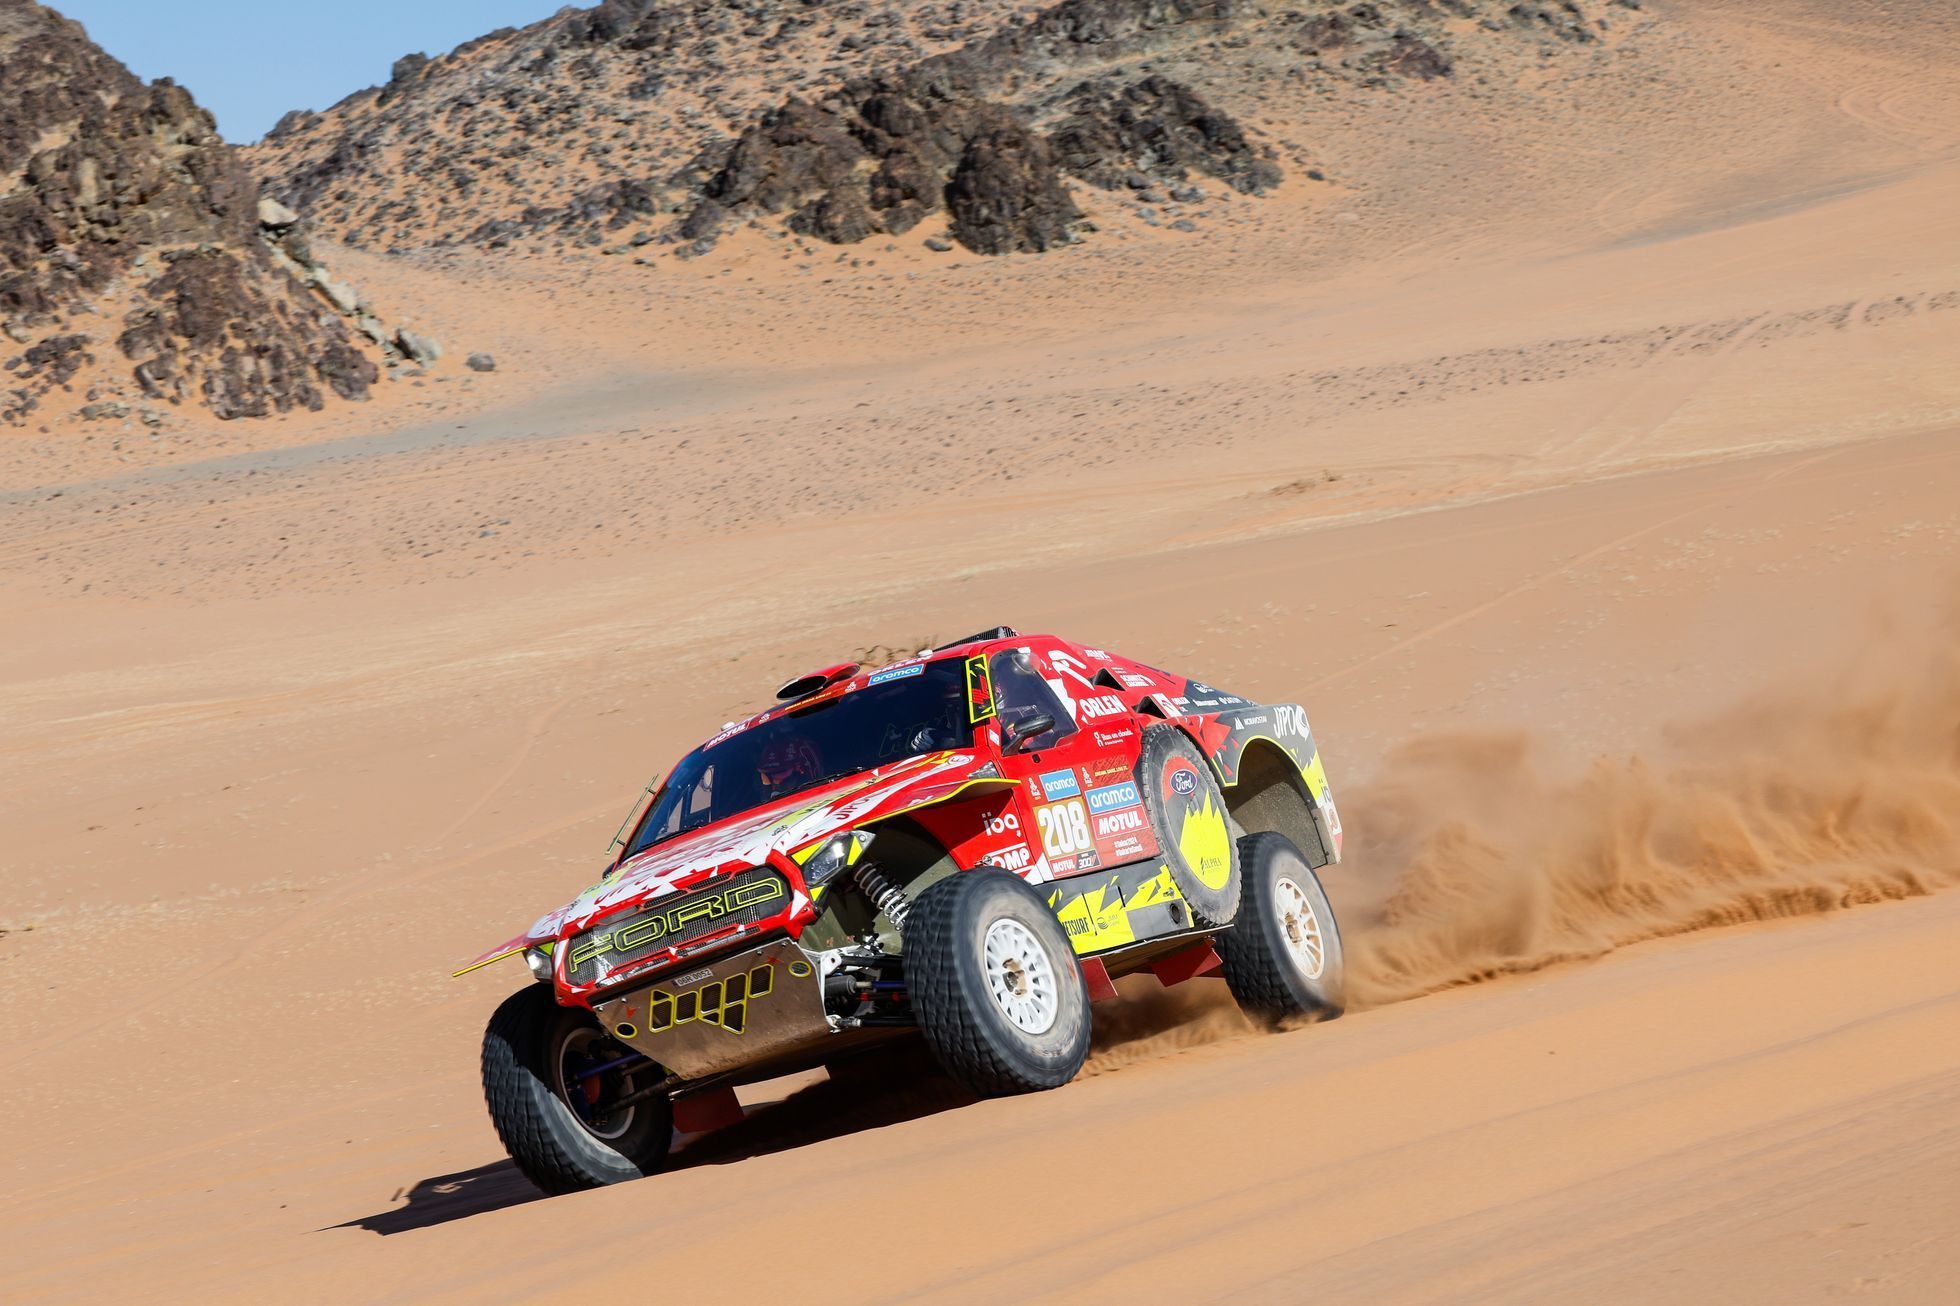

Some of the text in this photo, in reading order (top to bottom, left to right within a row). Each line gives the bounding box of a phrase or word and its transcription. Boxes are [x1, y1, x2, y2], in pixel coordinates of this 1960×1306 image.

[872, 667, 919, 682] aramco
[1080, 694, 1128, 718] ORLEN
[706, 723, 746, 748] MOTUL
[1046, 777, 1075, 792] aramco
[1175, 772, 1193, 791] Ford
[1091, 787, 1134, 808] aramco
[1038, 801, 1090, 858] 208
[1098, 810, 1142, 835] MOTUL
[1052, 859, 1076, 872] MOTUL
[570, 877, 783, 973] FORD
